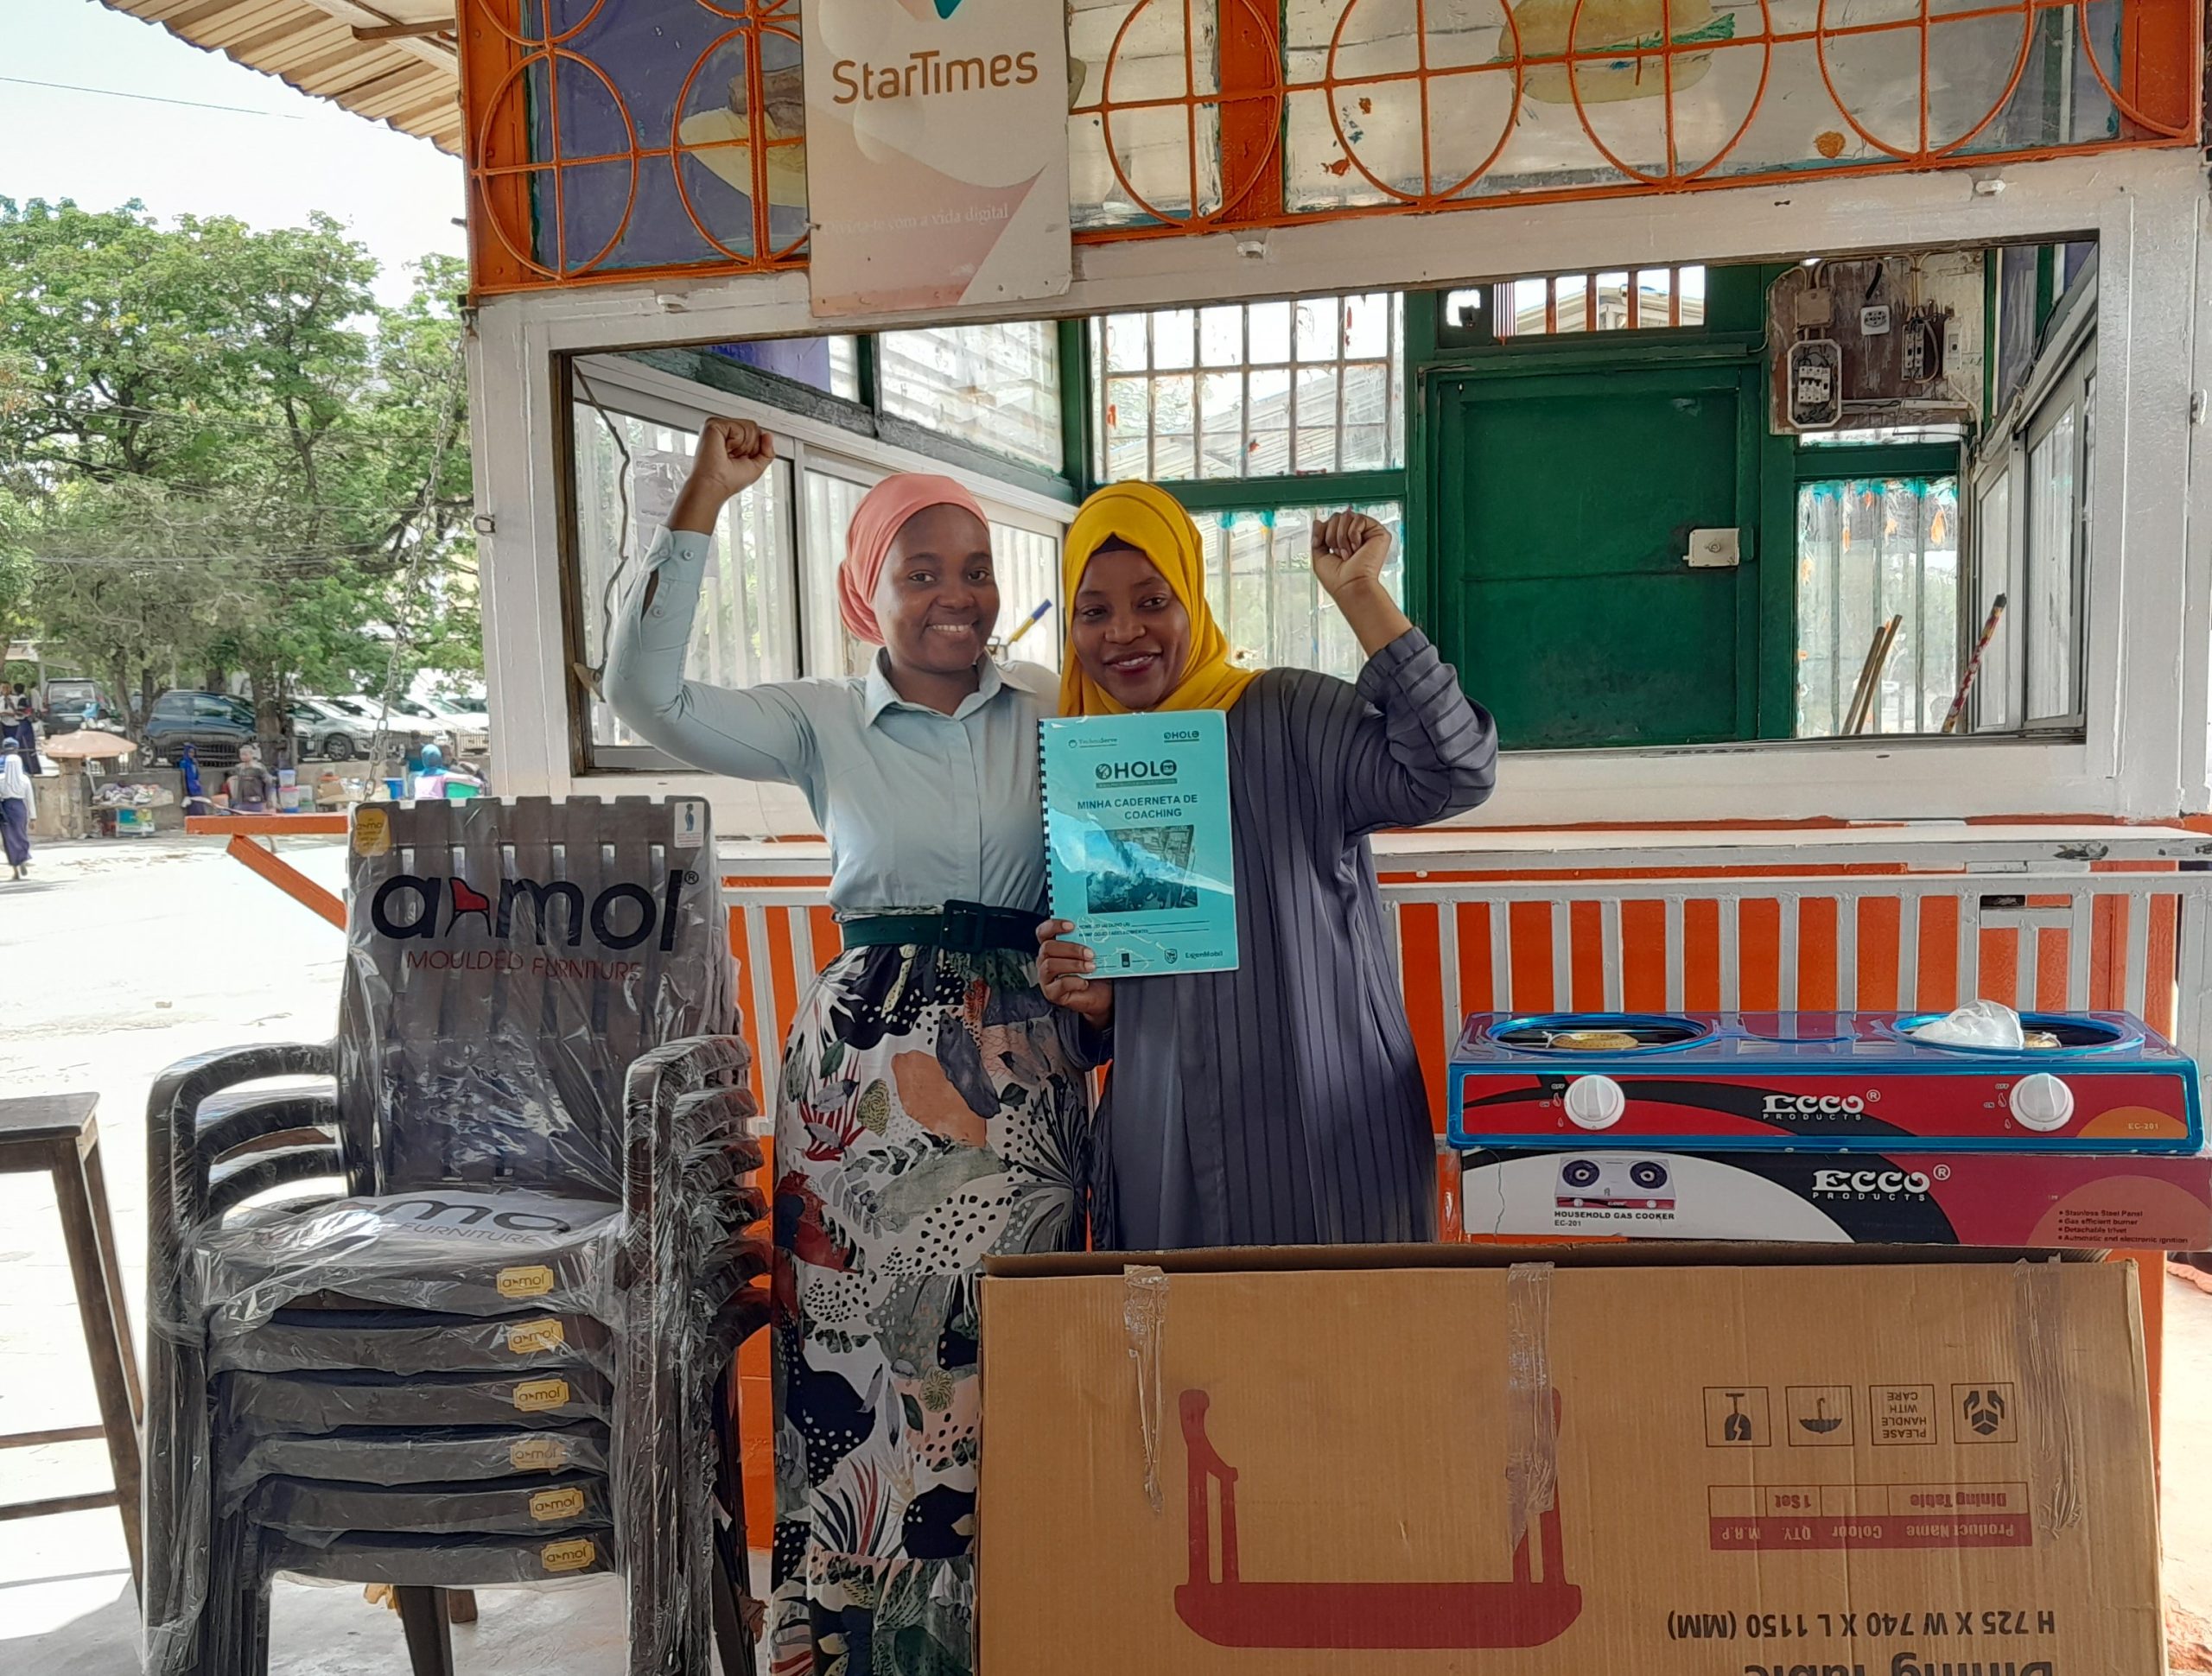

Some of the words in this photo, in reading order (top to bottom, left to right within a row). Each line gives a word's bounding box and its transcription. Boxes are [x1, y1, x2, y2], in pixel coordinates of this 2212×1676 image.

[832, 50, 1039, 105] StarTimes
[931, 207, 961, 225] vida
[965, 202, 1008, 225] digital
[1077, 799, 1112, 809] MINHA
[1114, 795, 1181, 808] CADERNETA
[1183, 794, 1198, 803] DE
[1124, 808, 1182, 820] COACHING
[407, 950, 524, 971] MOULDED
[1813, 1192, 1925, 1202] PRODUCTS
[397, 1222, 540, 1245] FURNITURE
[1887, 1391, 1918, 1401] CARE
[1890, 1404, 1918, 1413] WITH
[1881, 1417, 1927, 1426] HANDLE
[1882, 1429, 1927, 1438] PLEASE
[1775, 1495, 1802, 1509] Set
[1802, 1495, 1811, 1508] 1
[1910, 1493, 1953, 1508] Table
[1955, 1492, 2007, 1508] Dining
[1832, 1525, 1883, 1540] Colour
[1906, 1525, 1949, 1539] Name
[1955, 1524, 2014, 1537] Product
[1668, 1610, 1737, 1641] (MM)
[1746, 1613, 1808, 1637] 1150
[1817, 1614, 1831, 1636] L
[1840, 1613, 1858, 1636] X
[1866, 1612, 1914, 1636] 740
[1923, 1612, 1949, 1635] W
[1955, 1612, 1973, 1635] X
[1982, 1611, 2029, 1635] 725
[2037, 1610, 2055, 1634] H
